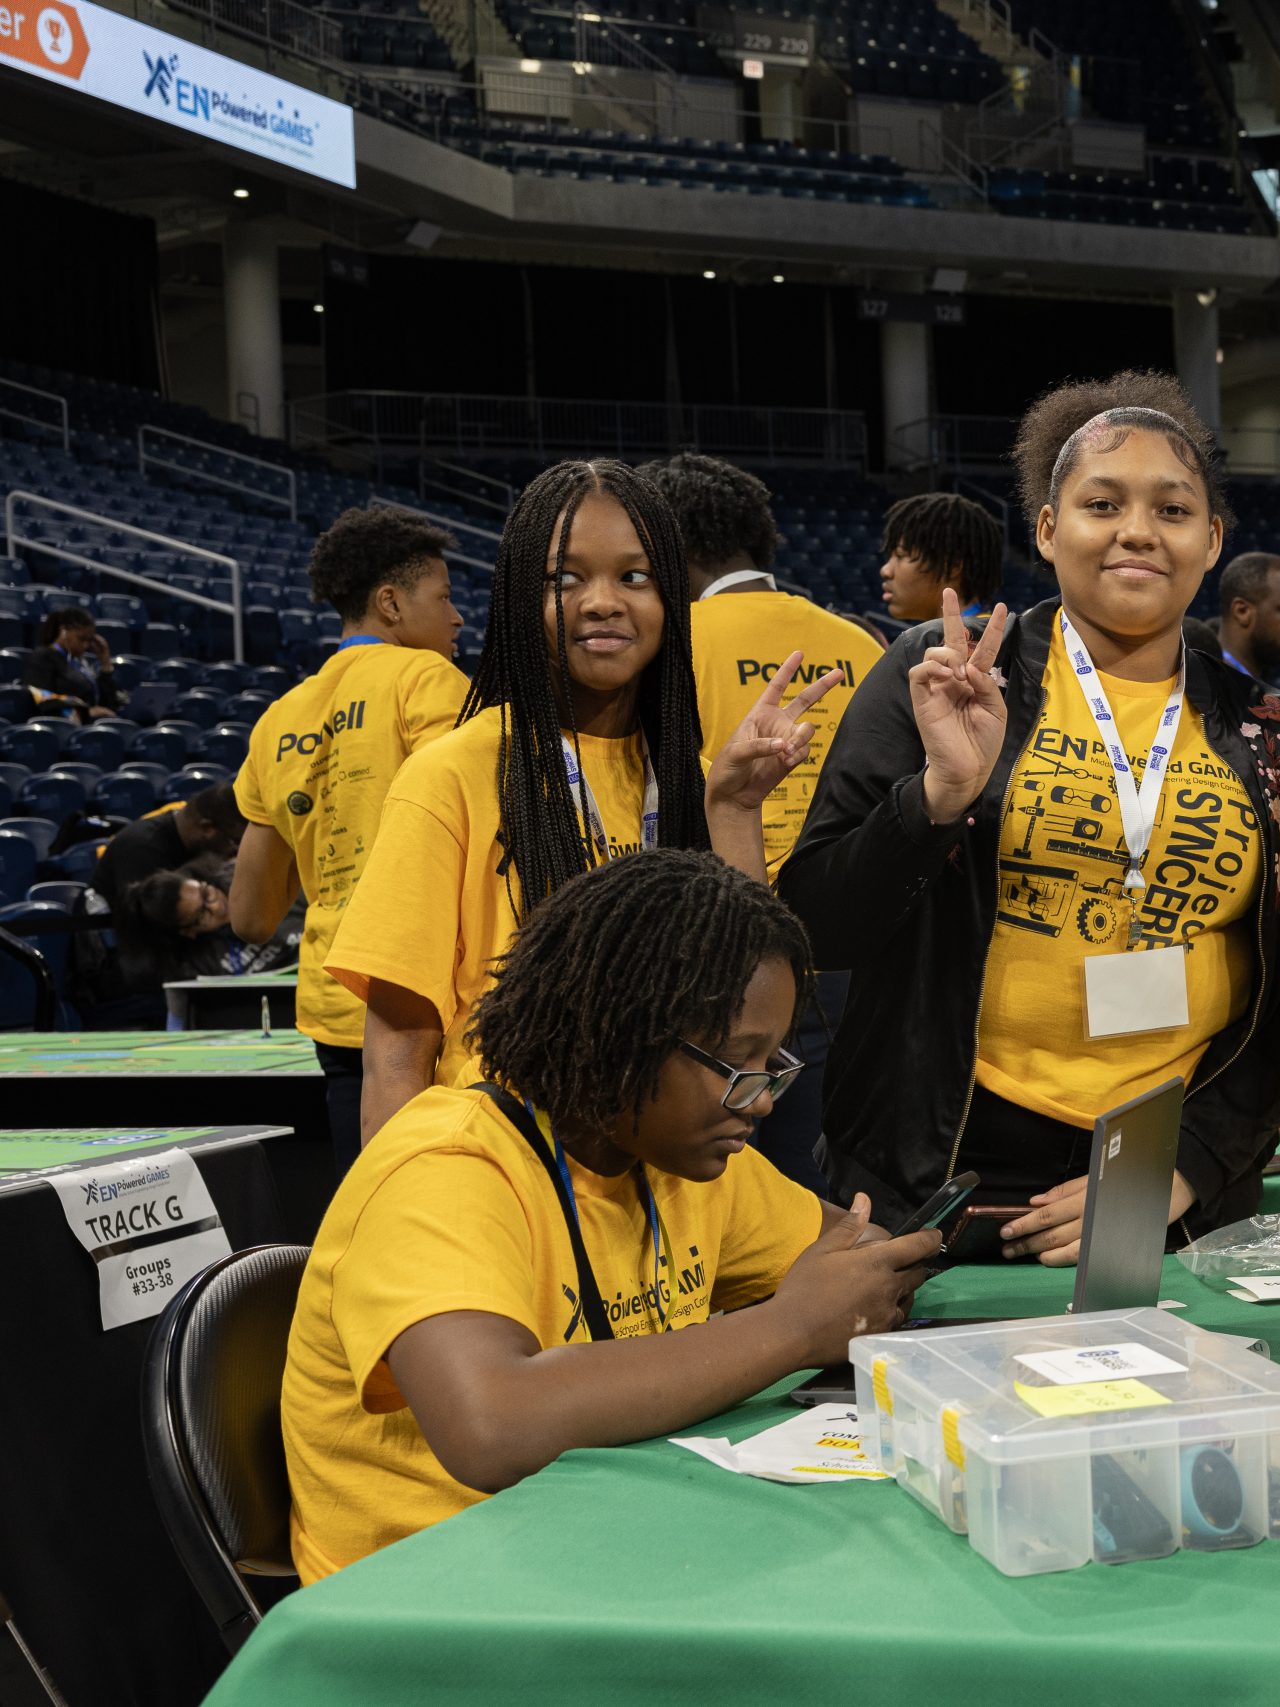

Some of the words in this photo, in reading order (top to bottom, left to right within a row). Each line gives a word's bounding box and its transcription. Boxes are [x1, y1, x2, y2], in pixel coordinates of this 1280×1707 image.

[176, 79, 210, 121] EN
[212, 92, 268, 130] Powered
[270, 112, 314, 147] GAMES
[1032, 728, 1089, 762] EN
[1192, 777, 1220, 789] Design
[1181, 797, 1259, 955] Project
[100, 1183, 118, 1202] EN
[117, 1175, 146, 1192] Powered
[146, 1169, 170, 1184] GAMES
[85, 1201, 162, 1243] TRACK
[165, 1195, 184, 1222] G
[125, 1257, 172, 1281] Groups
[132, 1273, 175, 1297] #33-38
